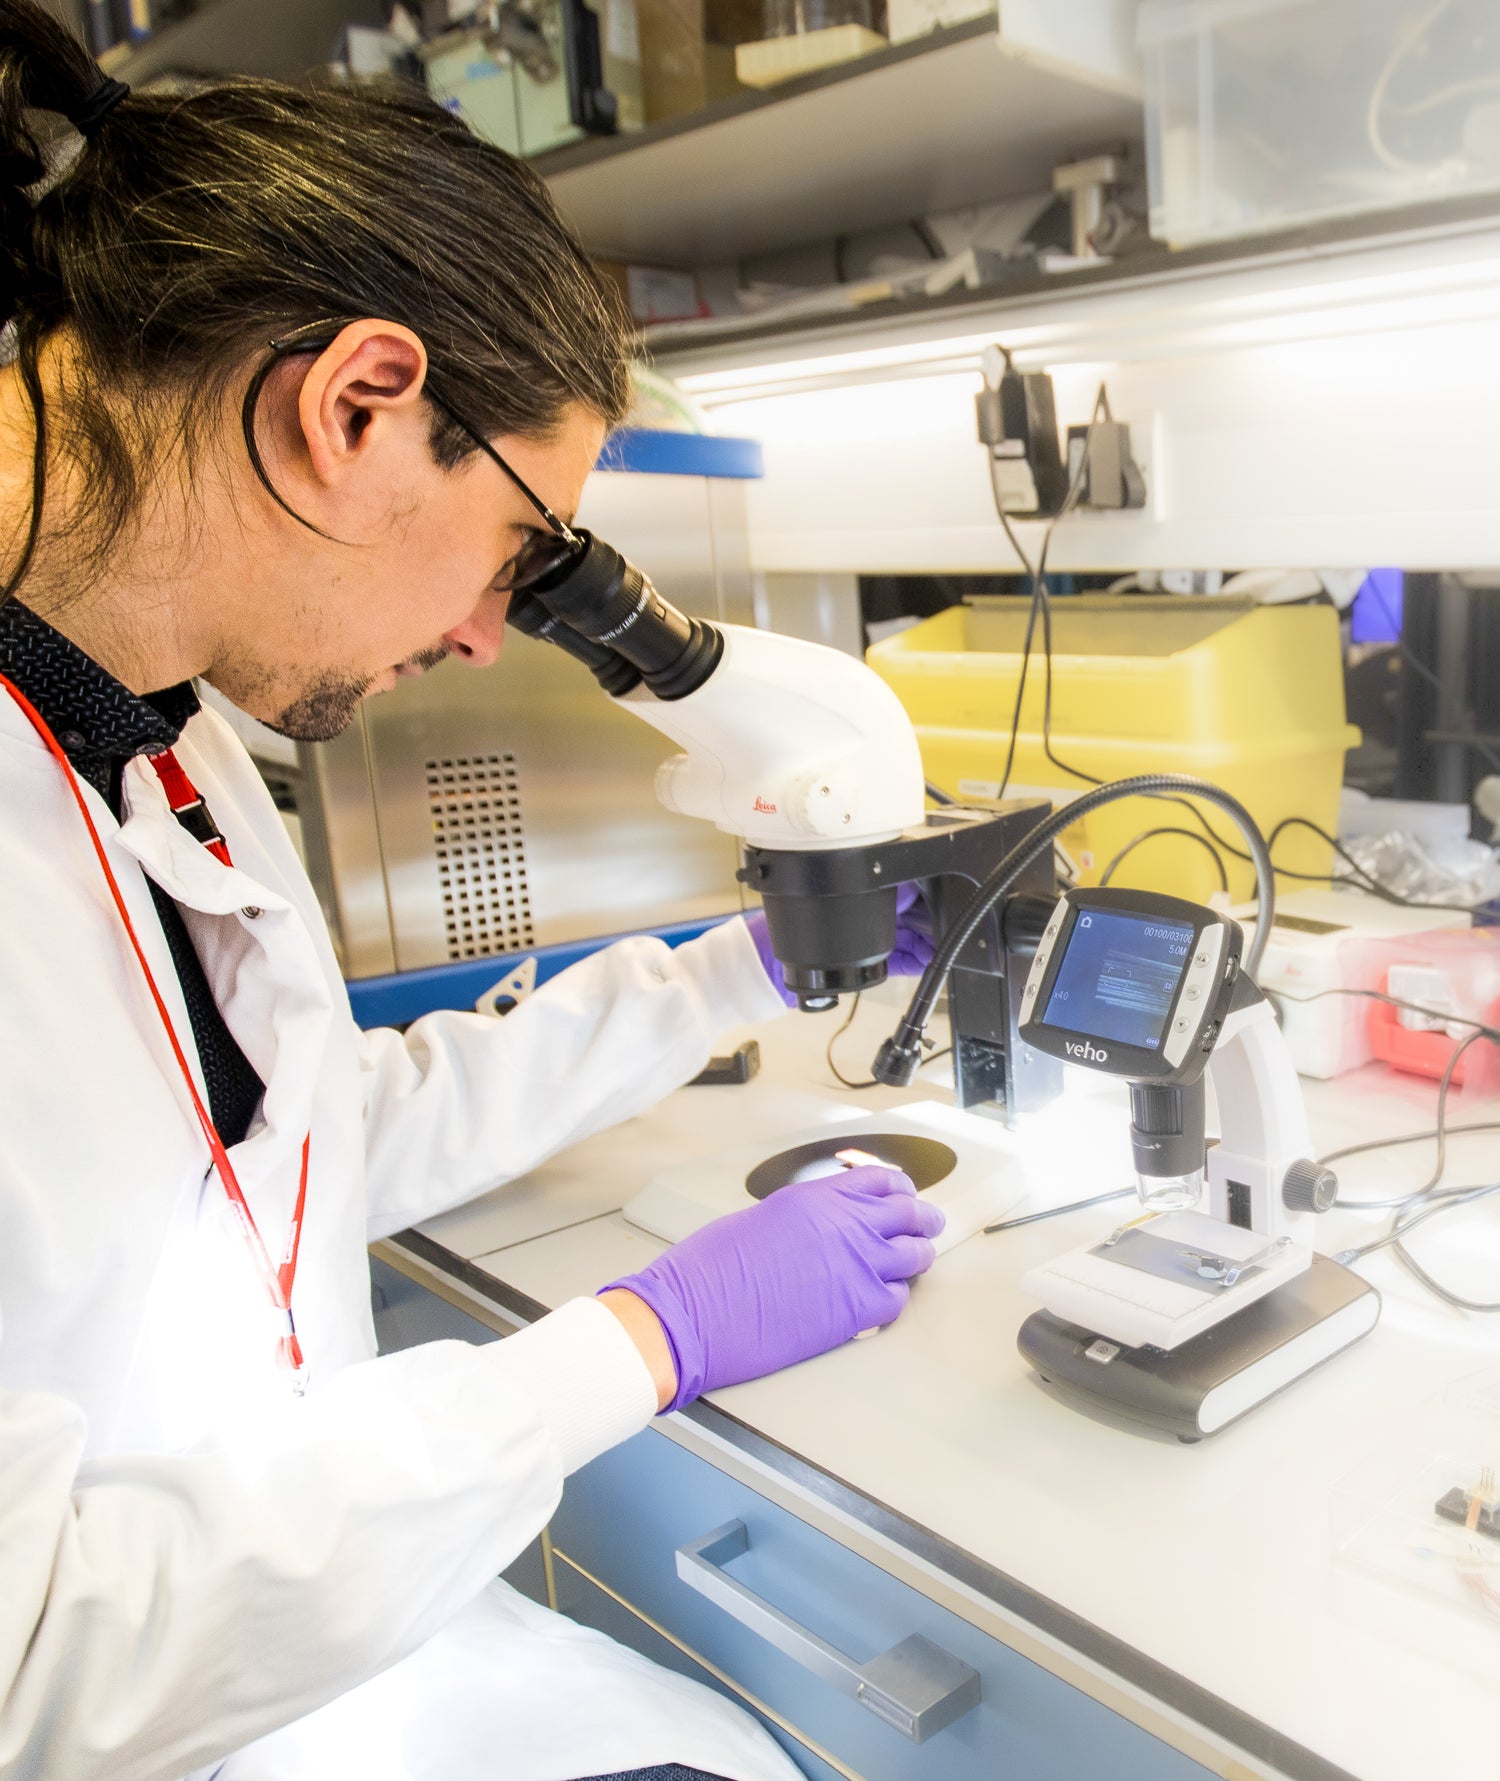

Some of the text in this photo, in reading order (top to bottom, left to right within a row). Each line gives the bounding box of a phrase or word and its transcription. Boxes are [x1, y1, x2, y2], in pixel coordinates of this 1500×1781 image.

[752, 795, 777, 814] Leica
[1143, 926, 1194, 944] 00100/03100
[1168, 944, 1187, 956] 5.0M
[1065, 1041, 1107, 1062] veho
